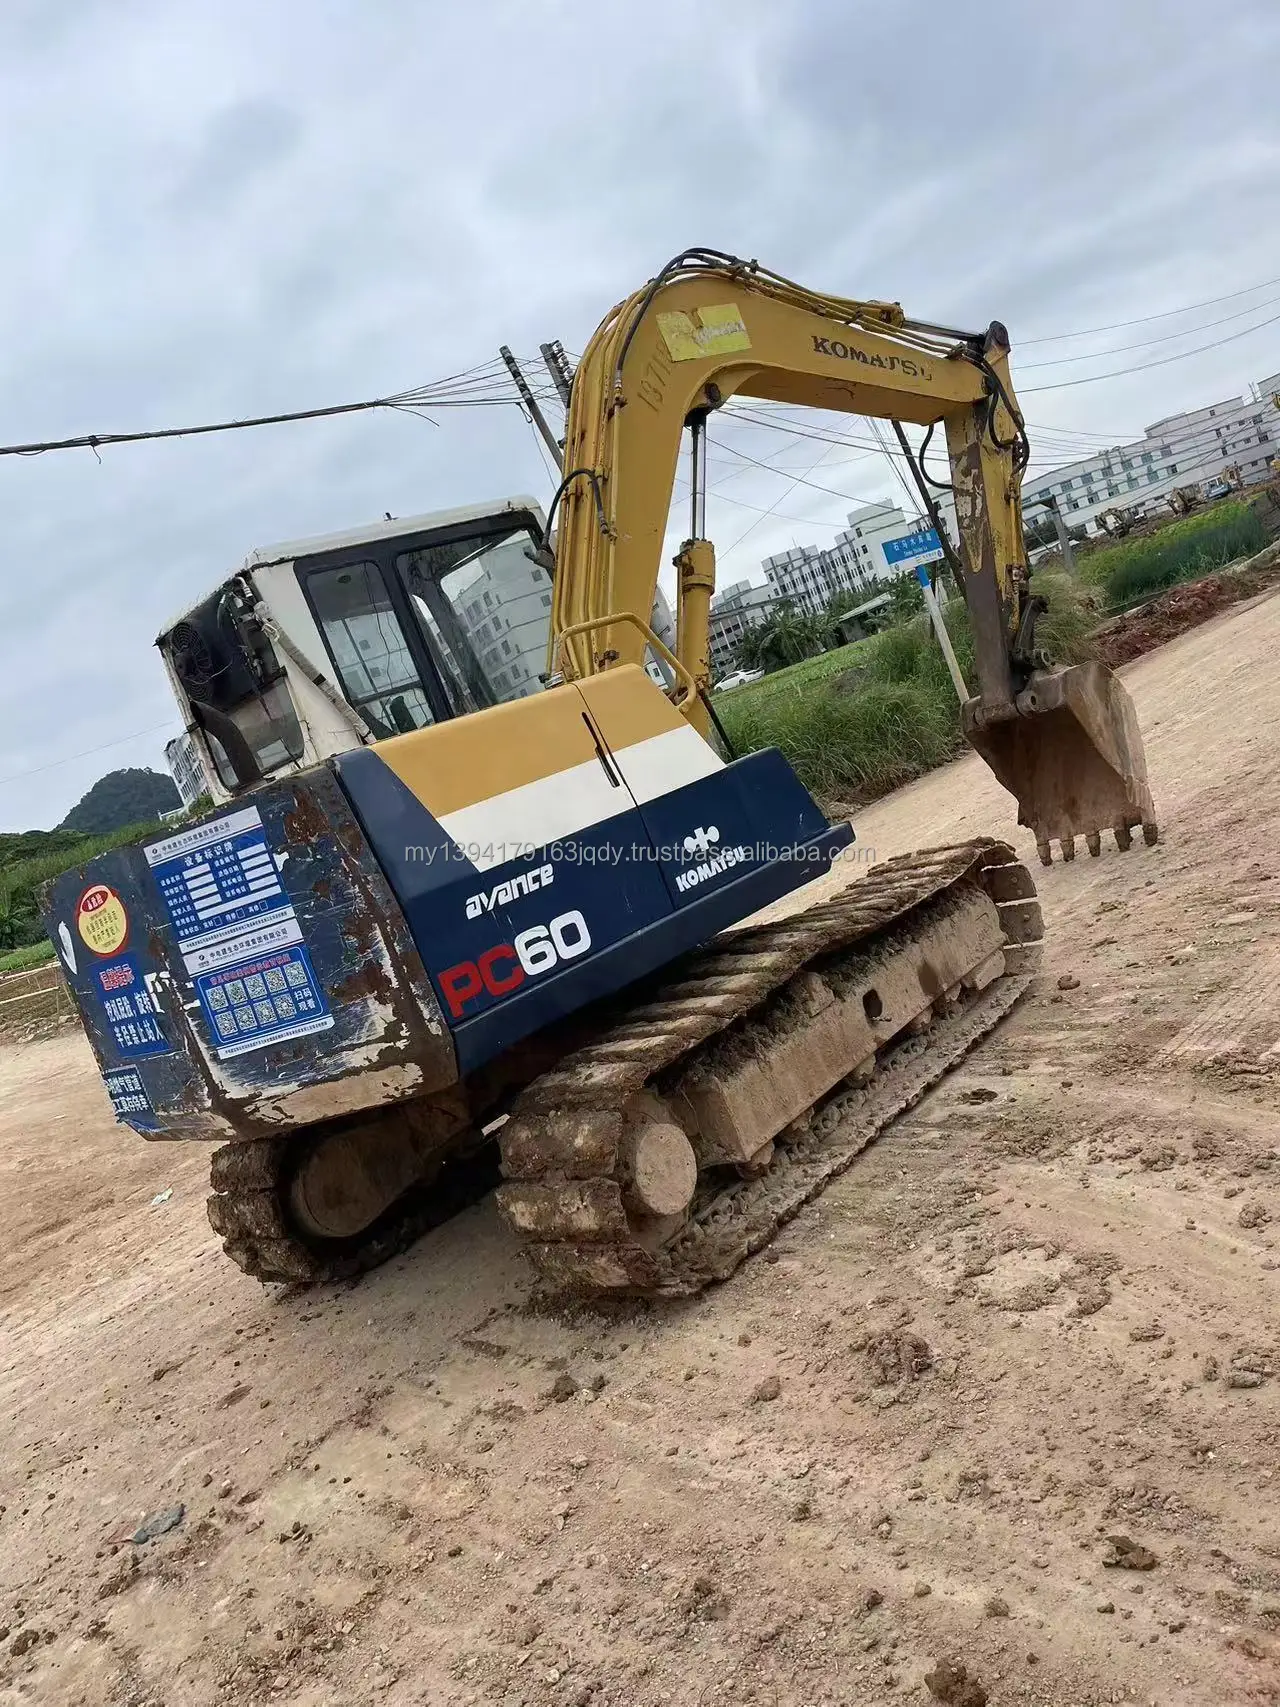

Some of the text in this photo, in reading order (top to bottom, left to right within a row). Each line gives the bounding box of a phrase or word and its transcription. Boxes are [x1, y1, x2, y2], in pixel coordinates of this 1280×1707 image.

[184, 841, 234, 867] 设备标识牌
[675, 845, 746, 893] KOMATSU
[209, 927, 288, 958] 中电建生态环境集团有限公司
[437, 909, 593, 1019] PC60
[295, 987, 313, 1001] 扫码
[298, 998, 316, 1011] 观看
[113, 1018, 164, 1048] 半径禁止站人
